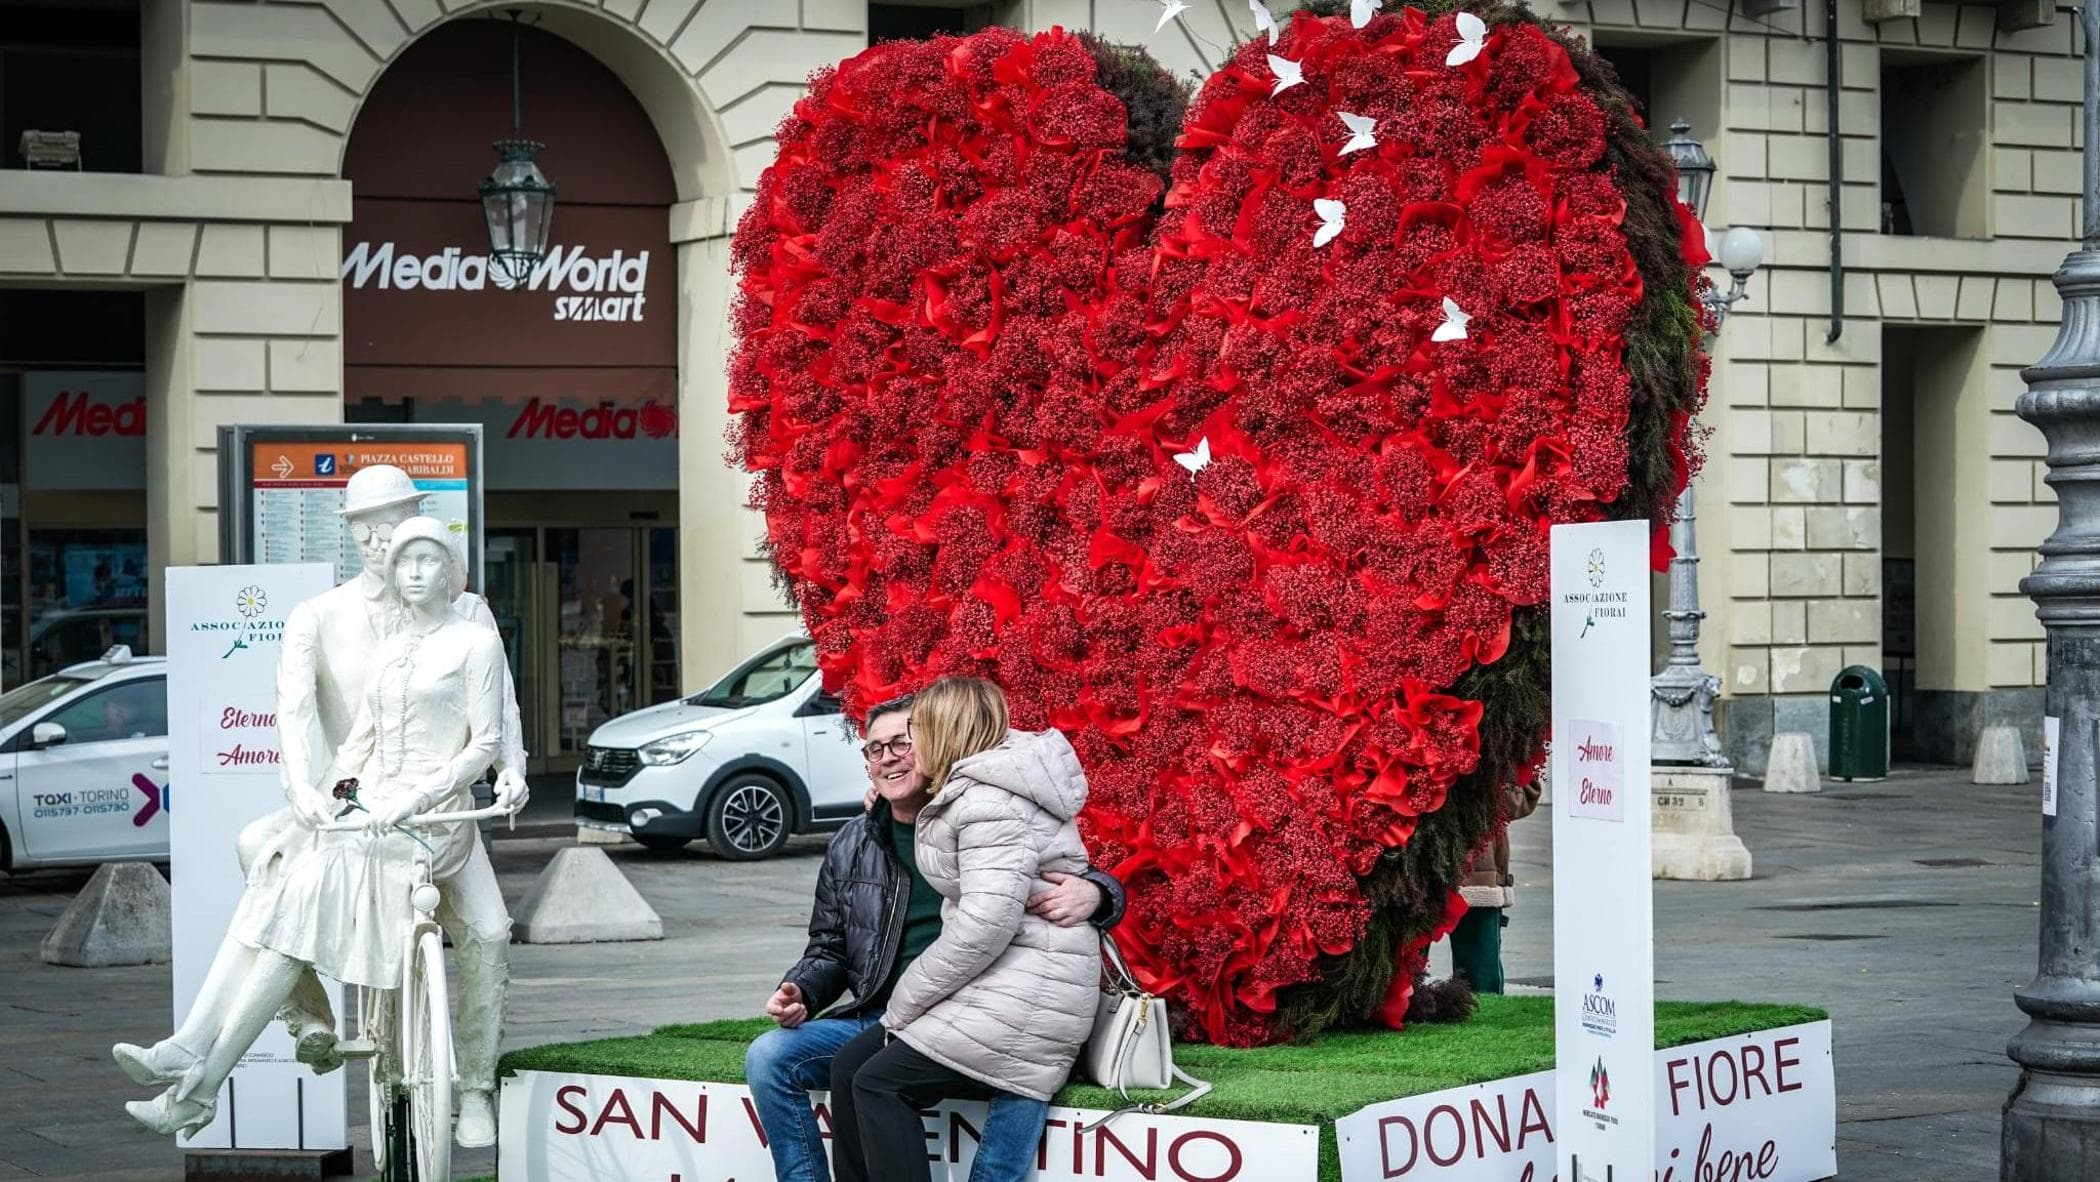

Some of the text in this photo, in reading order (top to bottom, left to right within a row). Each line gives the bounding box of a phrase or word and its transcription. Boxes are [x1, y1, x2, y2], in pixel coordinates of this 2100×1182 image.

[342, 241, 649, 292] Media World
[554, 292, 646, 321] smart
[32, 391, 147, 437] Med
[361, 453, 454, 464] PIAZZA CASTELLO
[1564, 592, 1627, 604] ASSOCIAZIONE
[1594, 607, 1626, 618] FIORAI
[220, 706, 277, 729] Eterno
[1578, 735, 1613, 762] Amore
[79, 788, 129, 802] TORINO
[1580, 778, 1612, 806] Eterno
[1583, 993, 1616, 1017] ASCOM
[556, 1085, 708, 1144] SAN
[1378, 1037, 1803, 1179] DONA FIORE
[1694, 1122, 1779, 1182] bene
